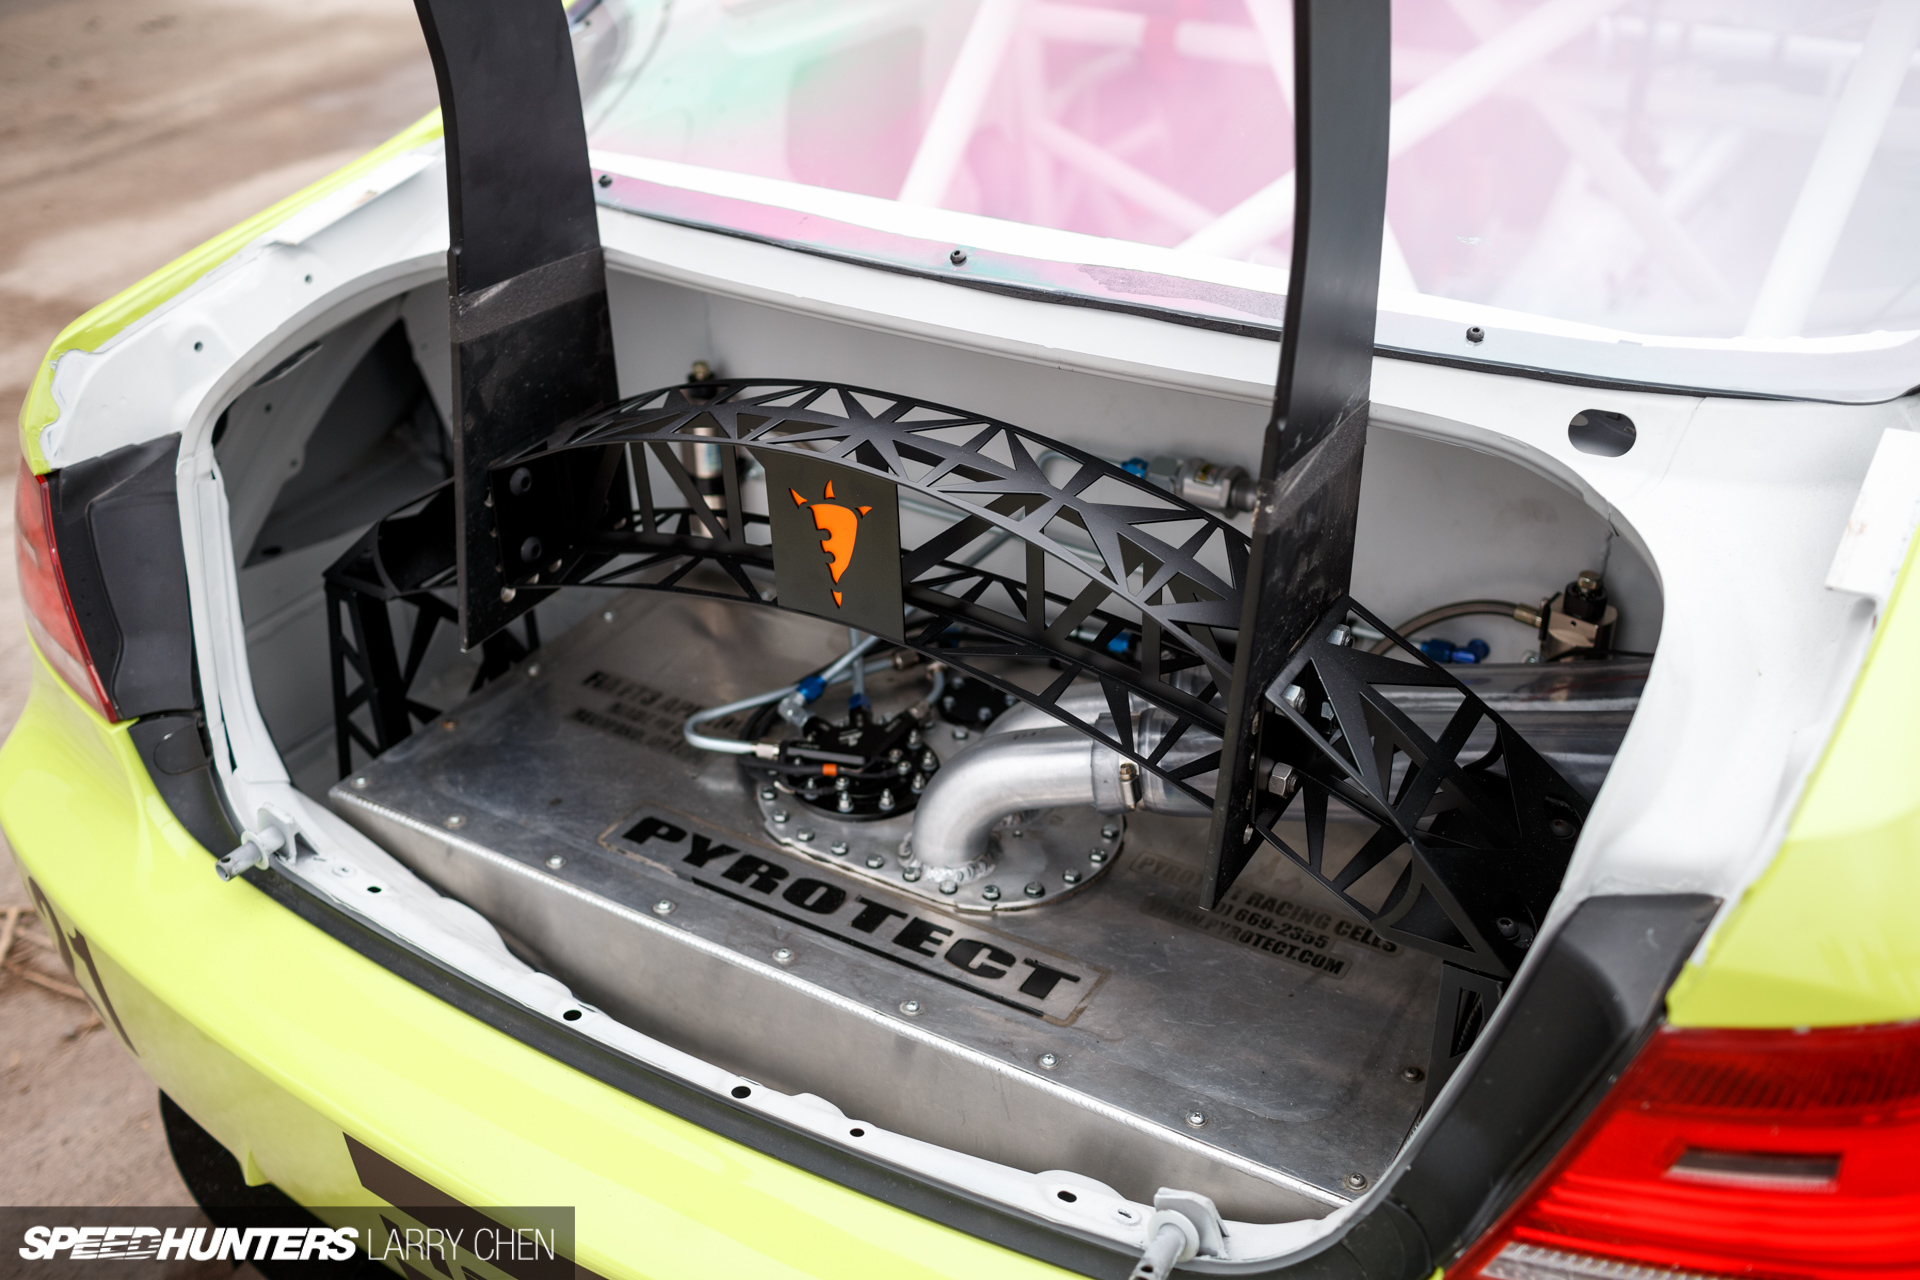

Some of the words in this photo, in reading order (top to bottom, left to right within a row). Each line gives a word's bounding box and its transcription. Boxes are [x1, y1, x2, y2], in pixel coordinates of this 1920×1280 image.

[622, 816, 1081, 999] PYROTECT
[1148, 895, 1345, 975] WWW.PYROTECT.COM
[1235, 905, 1330, 949] 669-2355
[1245, 890, 1331, 930] RACING
